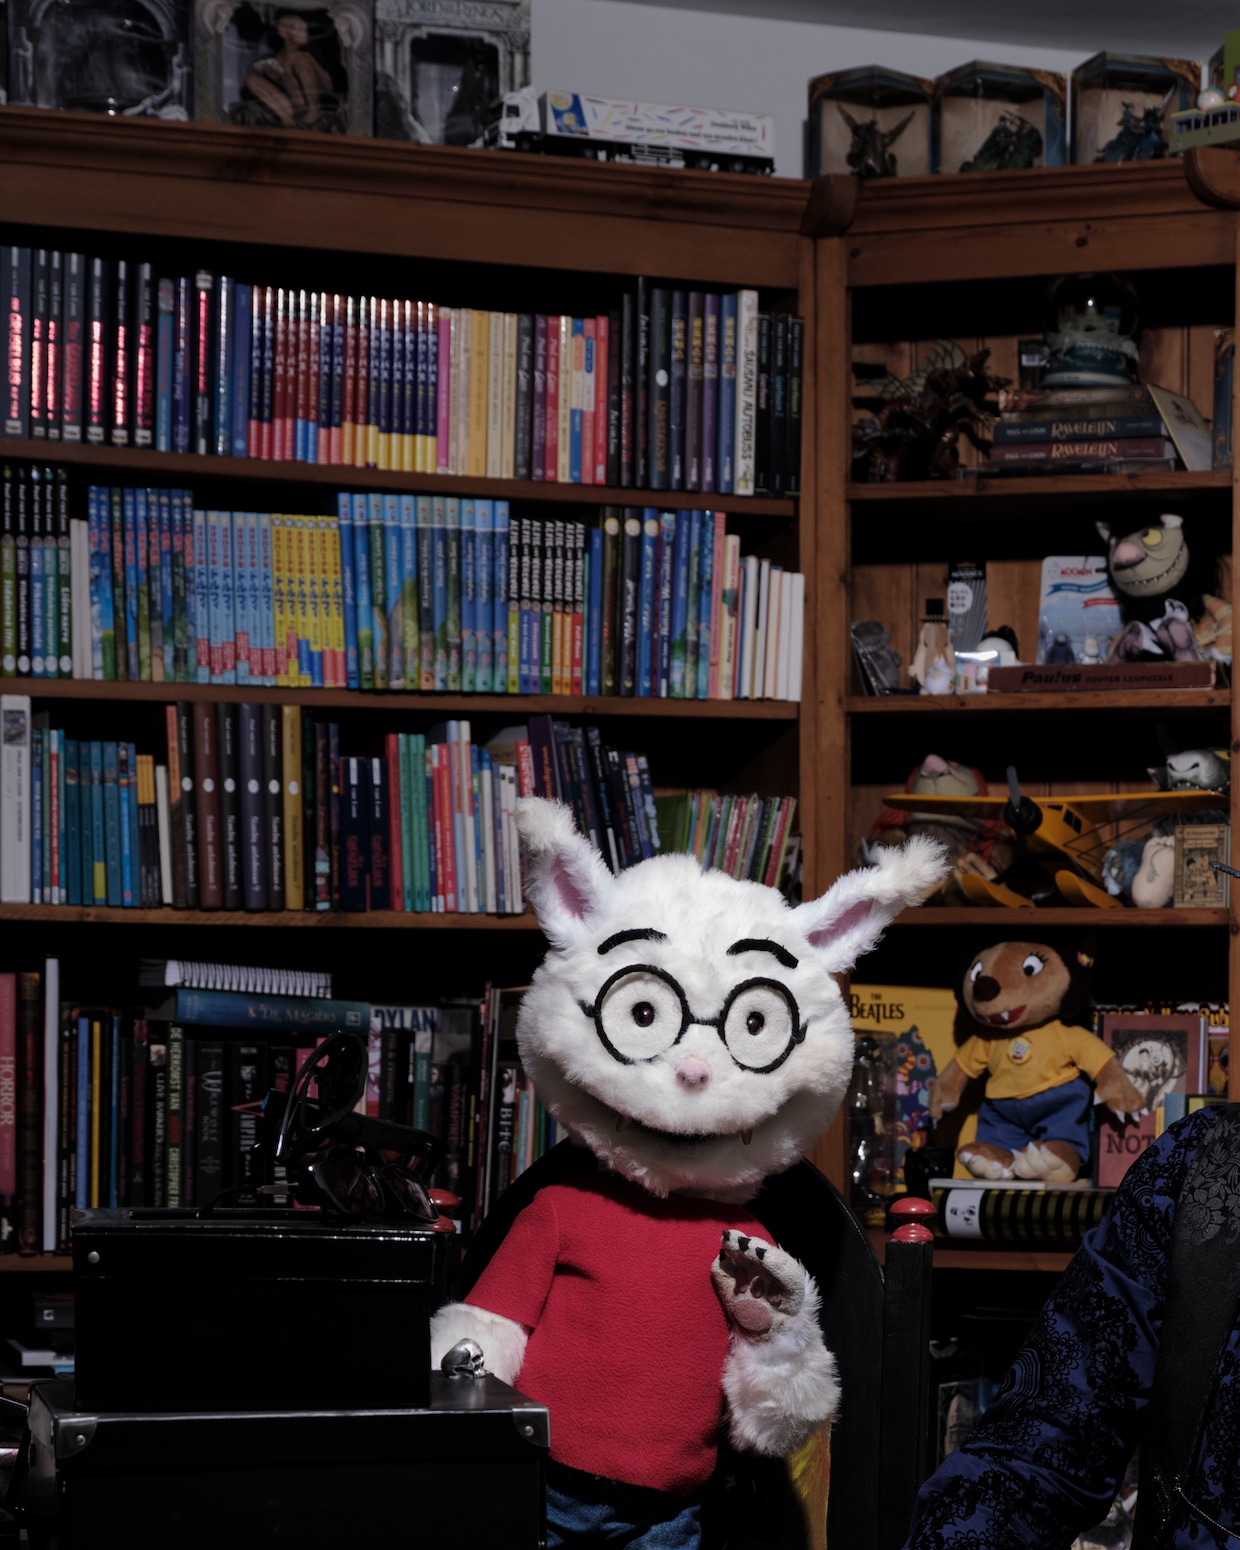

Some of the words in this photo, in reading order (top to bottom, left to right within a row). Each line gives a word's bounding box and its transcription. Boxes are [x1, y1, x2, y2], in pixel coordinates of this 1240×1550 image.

[375, 1007, 440, 1032] DYLAN
[850, 993, 905, 1023] BEATLES
[170, 1027, 181, 1038] DE
[170, 1039, 181, 1090] HERKOMST
[0, 1056, 16, 1126] HORROR
[170, 1091, 181, 1110] VAN
[168, 1147, 180, 1194] CHRISTOPHER
